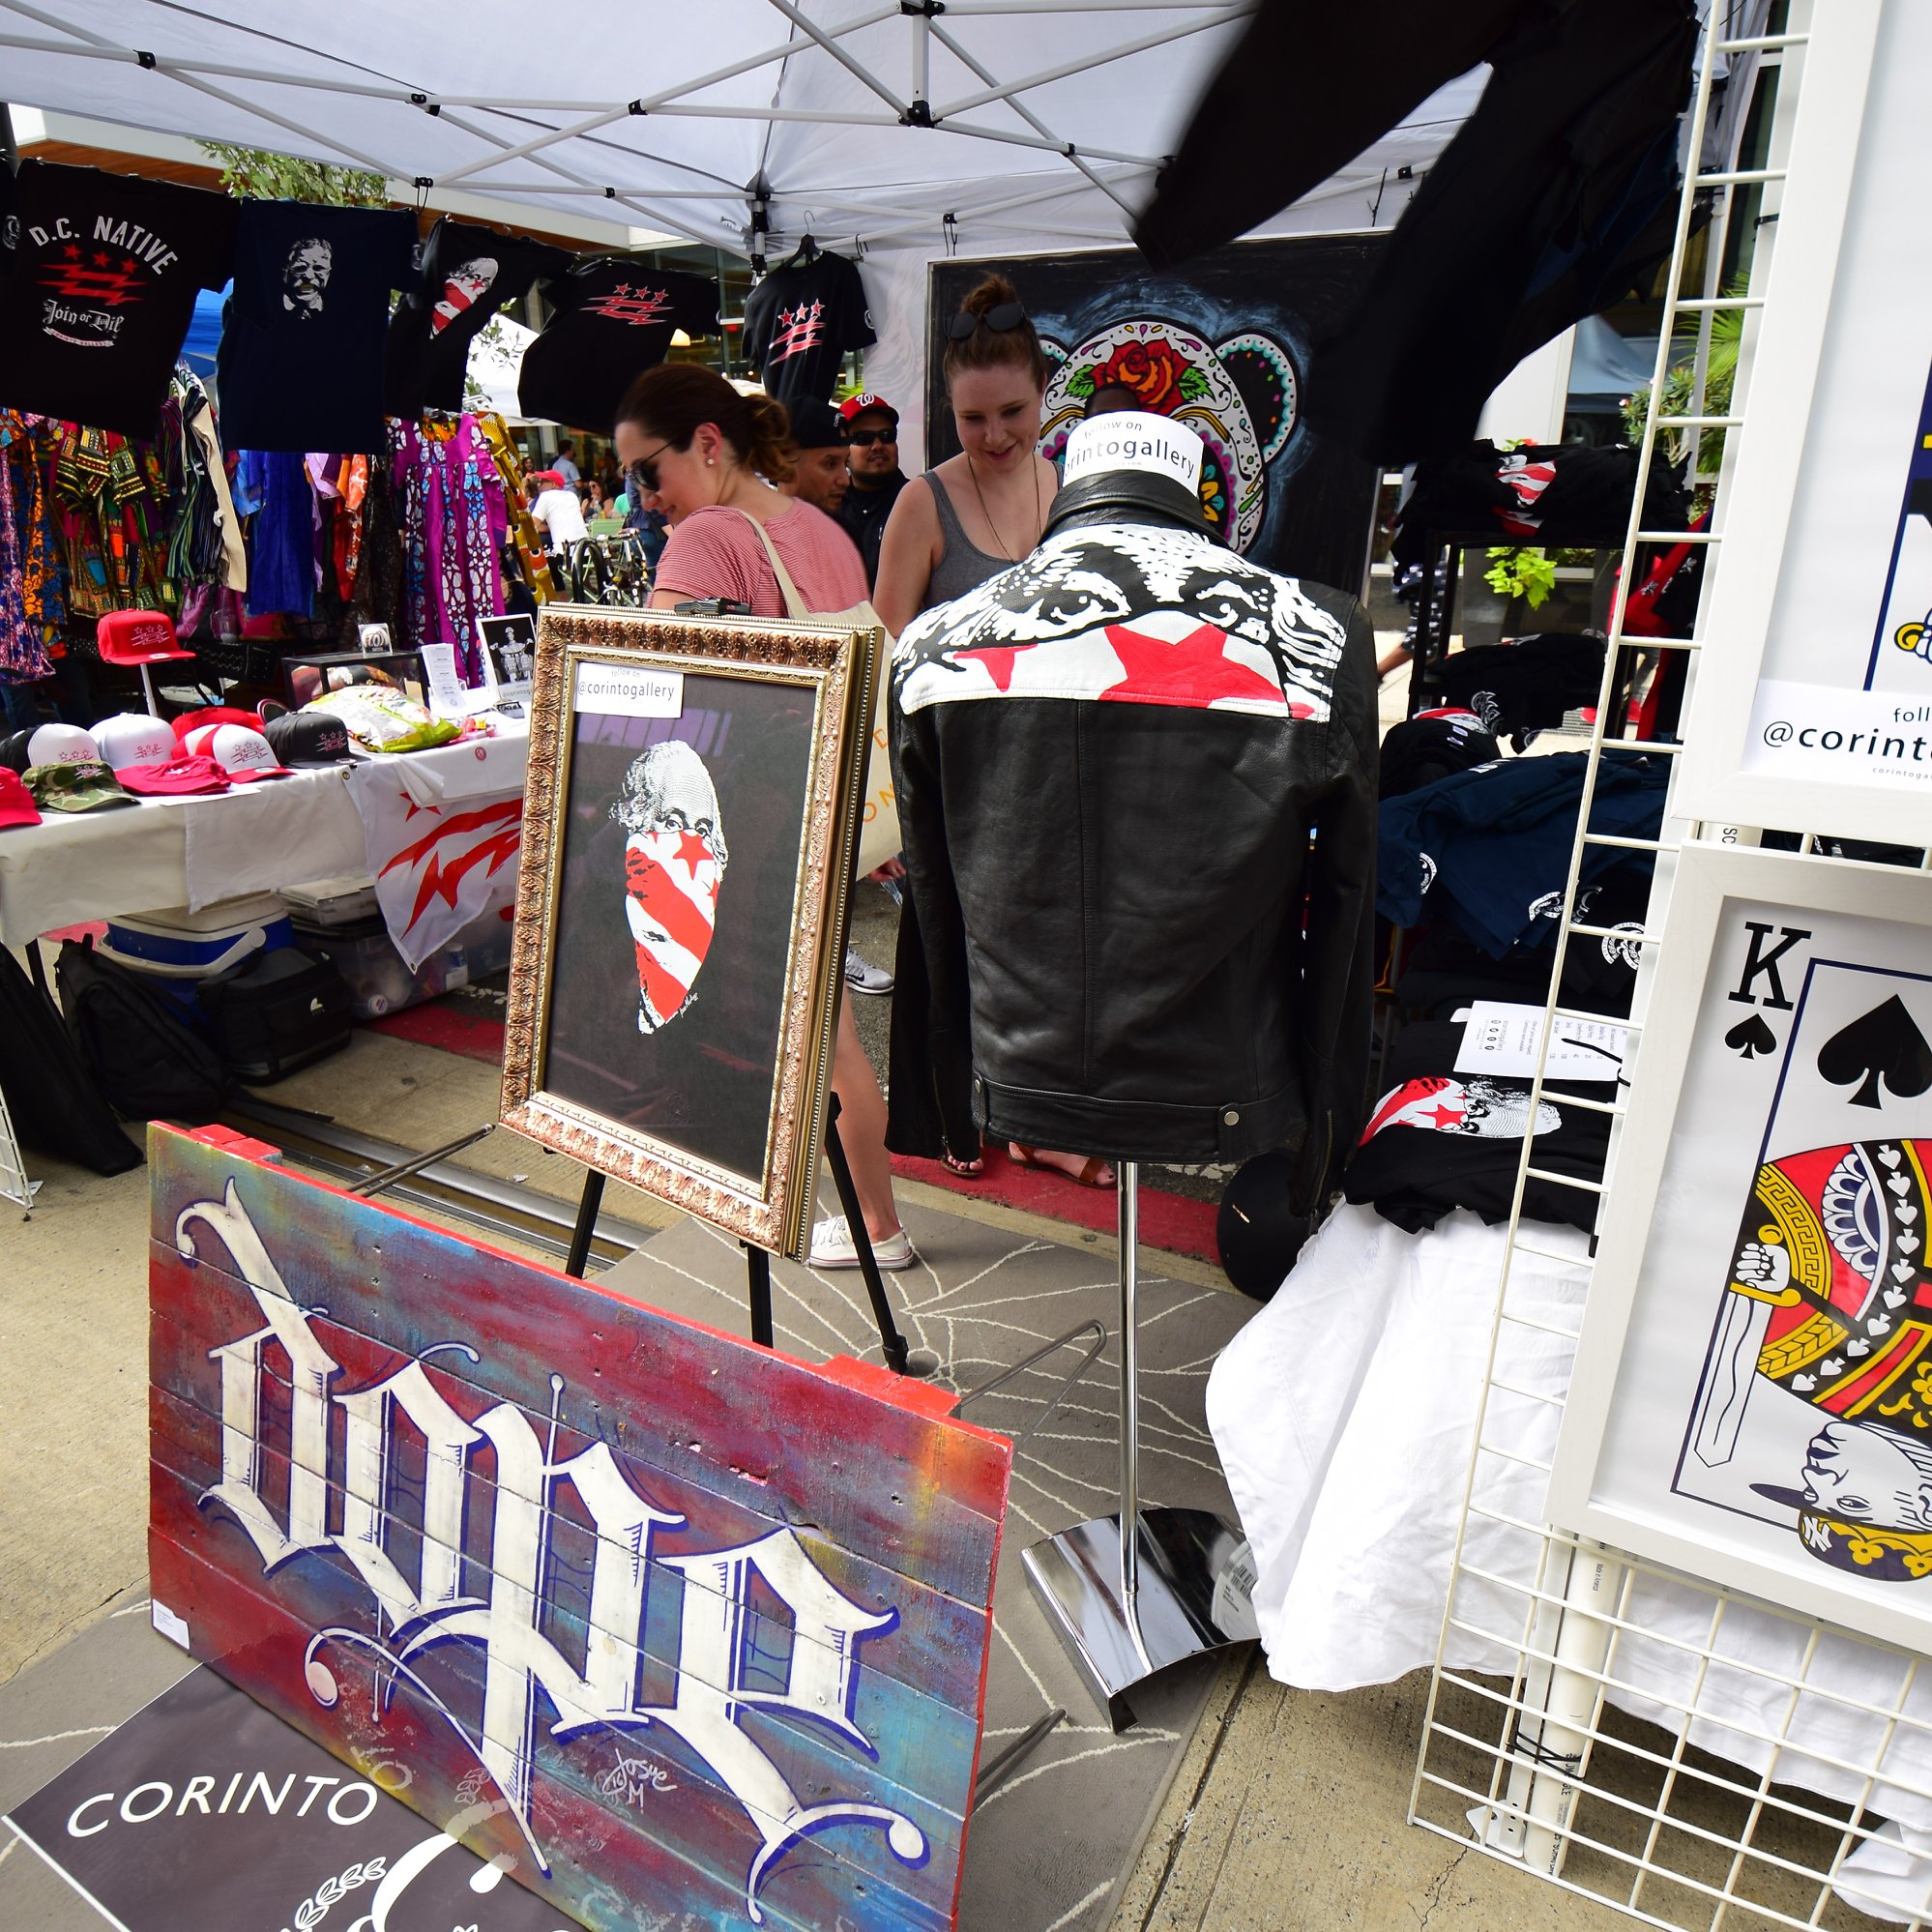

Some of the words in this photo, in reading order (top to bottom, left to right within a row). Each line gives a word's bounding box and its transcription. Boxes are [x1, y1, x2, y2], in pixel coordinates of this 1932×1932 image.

[29, 218, 80, 247] D.C.
[93, 216, 179, 276] NATIVE
[43, 299, 78, 325] Join
[79, 313, 93, 323] or
[1126, 421, 1143, 432] on
[578, 681, 675, 701] @corintogallery
[1763, 720, 1932, 761] @corint
[1728, 921, 1812, 1011] K
[67, 1771, 378, 1838] CORINTO
